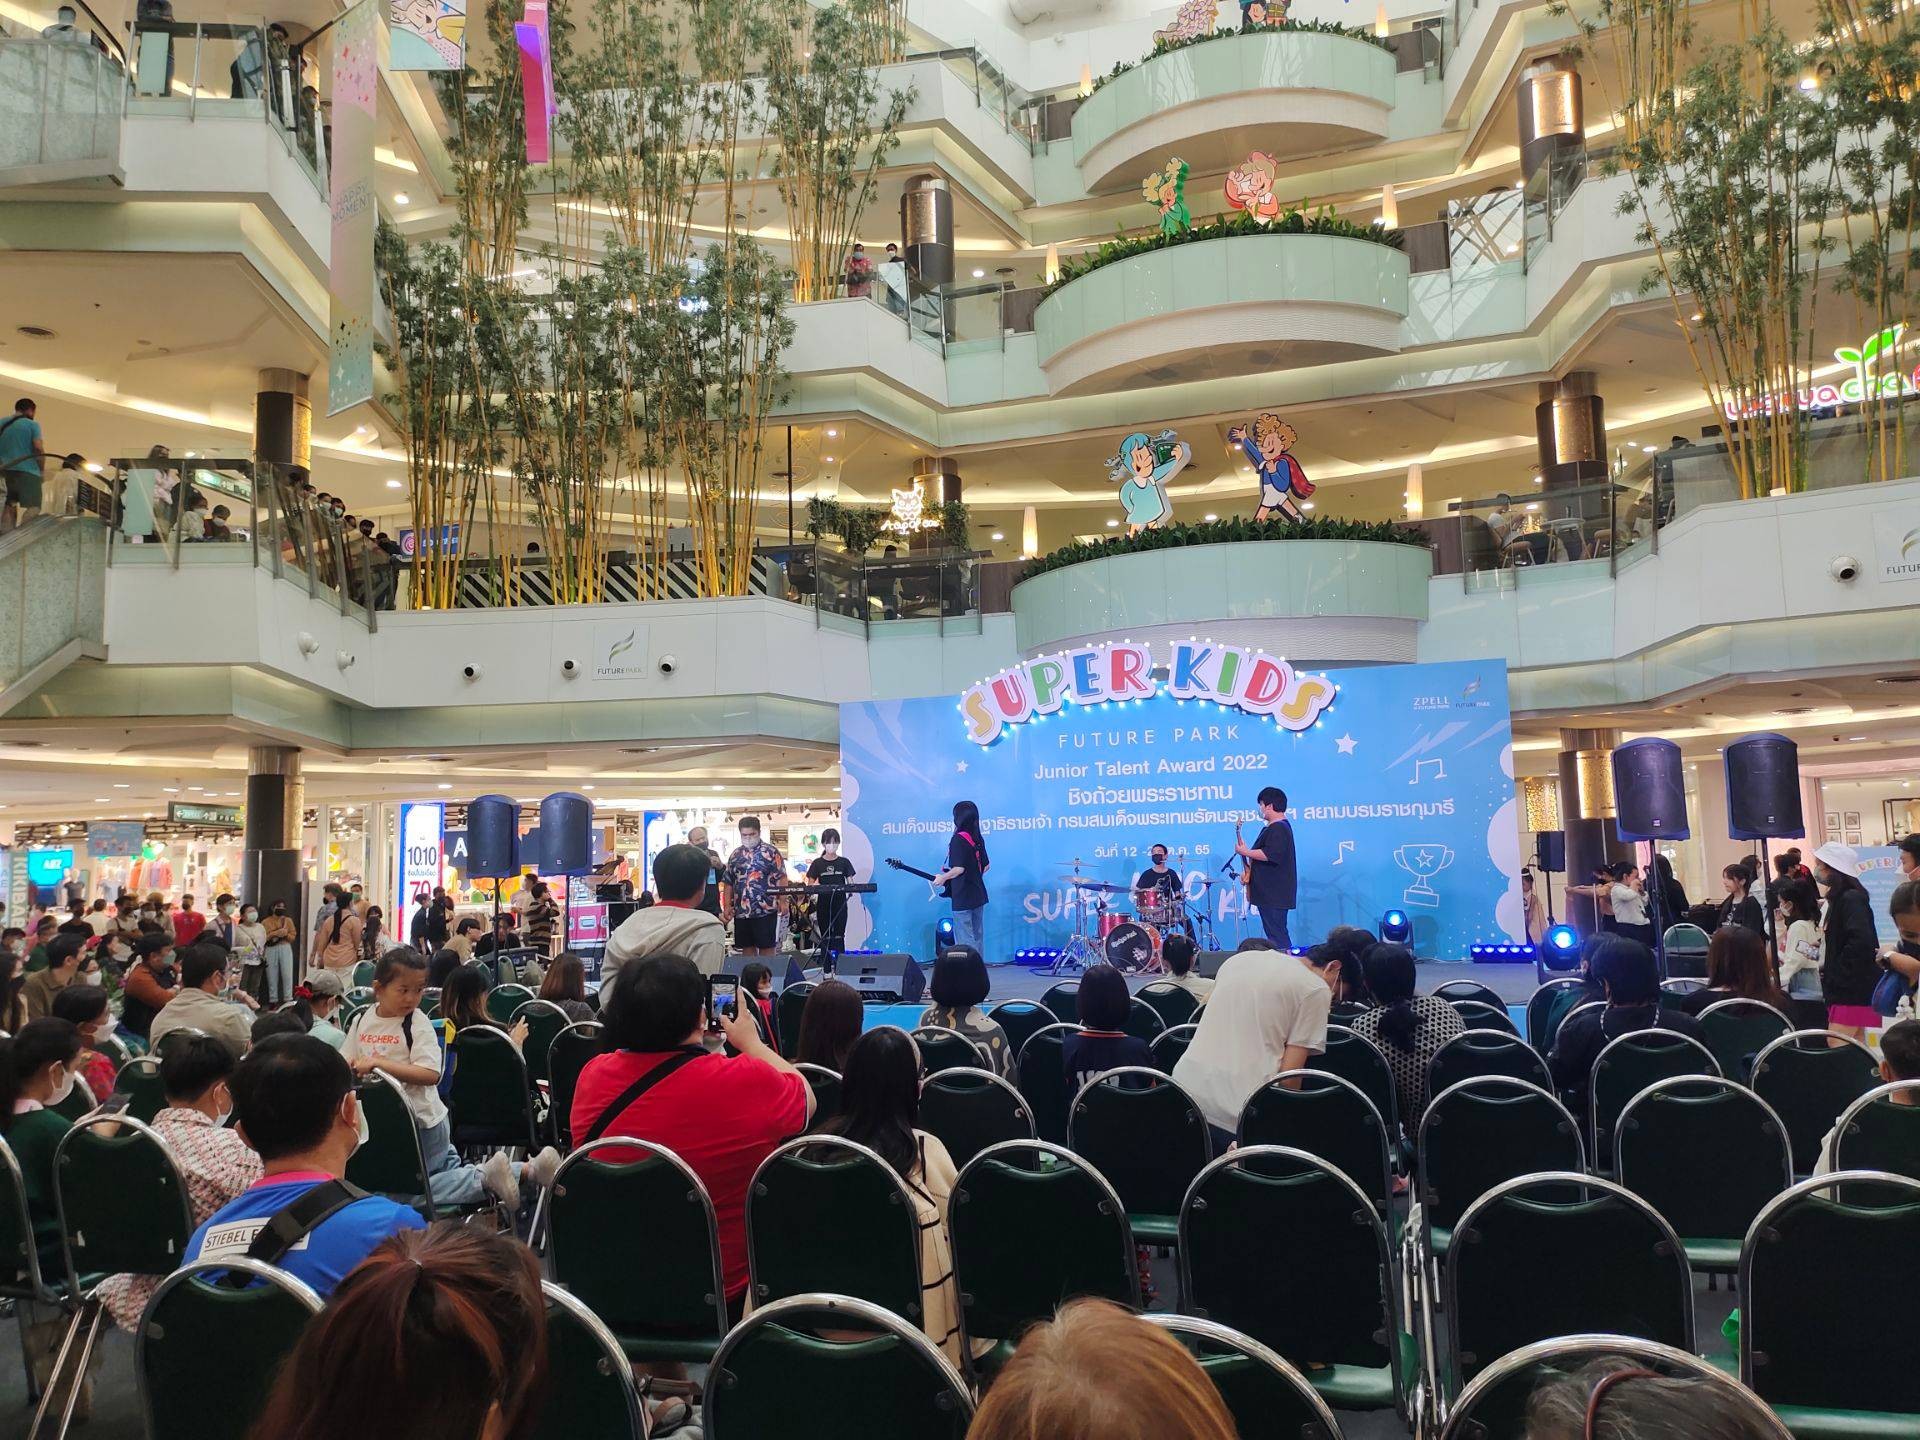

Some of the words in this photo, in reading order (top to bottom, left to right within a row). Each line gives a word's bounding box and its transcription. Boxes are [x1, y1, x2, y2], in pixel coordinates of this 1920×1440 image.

[964, 648, 1149, 738] SUPER
[1174, 645, 1327, 722] KIDS
[1059, 730, 1155, 748] FUTURE
[1174, 725, 1240, 743] PARK
[1034, 763, 1089, 781] Junior
[1095, 760, 1150, 777] Talent
[1157, 757, 1216, 774] Award
[1223, 753, 1268, 771] 2022
[1068, 784, 1233, 806] ชิงถ้วยพระราชทาน
[1304, 798, 1455, 821] สยามบรมราชกุมารี
[407, 846, 437, 866] 10.10
[1094, 843, 1119, 858] วันที่
[1122, 846, 1137, 858] 12
[1195, 844, 1210, 855] 65
[1855, 857, 1893, 873] UPER
[359, 1033, 400, 1045] KECHERS
[205, 1229, 247, 1249] STIEBEL
